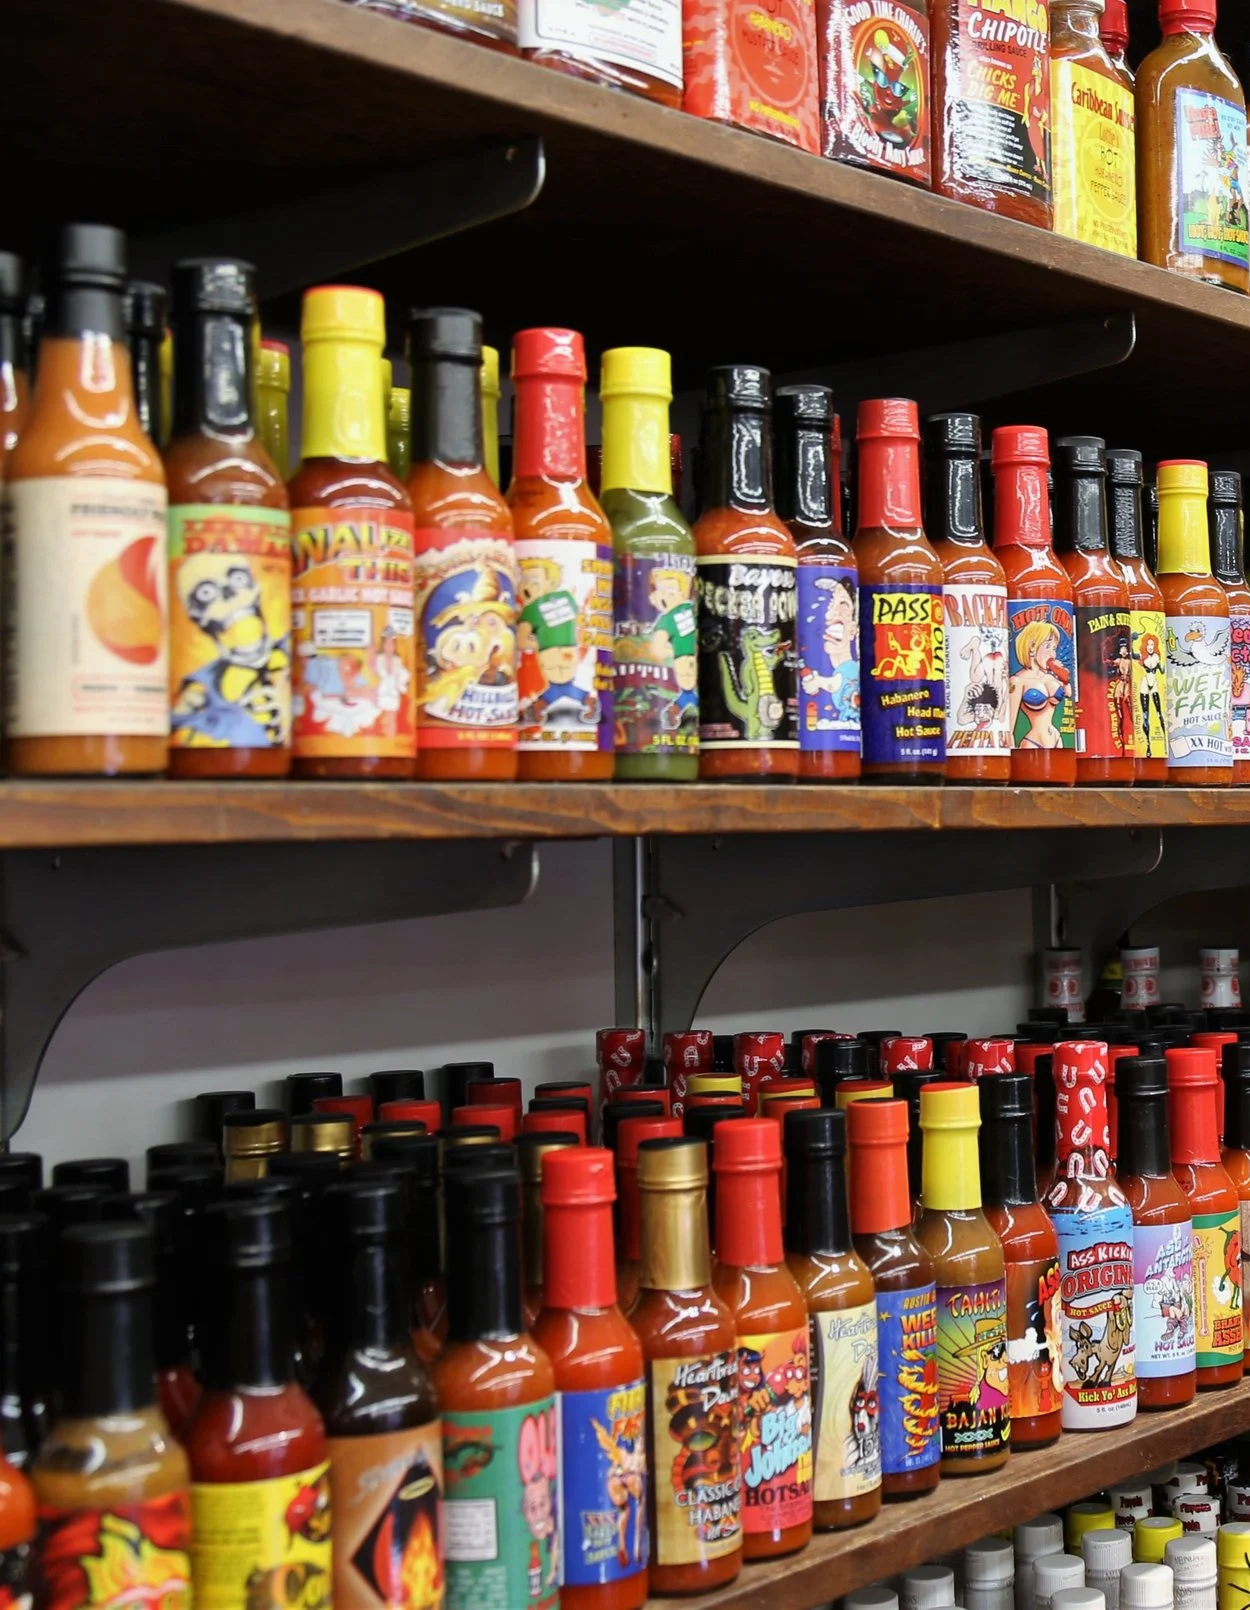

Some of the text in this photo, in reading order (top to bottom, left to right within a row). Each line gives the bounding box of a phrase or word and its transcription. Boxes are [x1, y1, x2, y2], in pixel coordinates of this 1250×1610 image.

[845, 1, 871, 26] GOOD
[871, 0, 894, 18] TIME
[967, 11, 1047, 54] CHIPOTLE
[967, 60, 1017, 90] CHICKS
[967, 81, 1019, 108] DIG ME
[1071, 81, 1113, 120] Caribbean
[878, 597, 930, 622] PASS
[1011, 605, 1050, 631] HOT
[1172, 671, 1222, 696] WET
[880, 689, 930, 706] Habanero
[1175, 690, 1230, 717] FART
[907, 706, 932, 718] Head
[1183, 713, 1223, 726] HOT SAUCE
[896, 725, 941, 738] Hot Sauce
[1190, 737, 1224, 751] XX HOT
[1070, 1250, 1096, 1267] ASS
[1069, 1303, 1112, 1317] HOT SAUCE
[1155, 1341, 1174, 1352] HOT
[1078, 1387, 1128, 1402] Kick Yo' Ass
[761, 1409, 798, 1445] Big
[945, 1410, 996, 1429] BAJAN
[954, 1429, 993, 1443] XXX
[960, 1442, 983, 1451] PEPPER
[984, 1439, 1000, 1449] SAUCE
